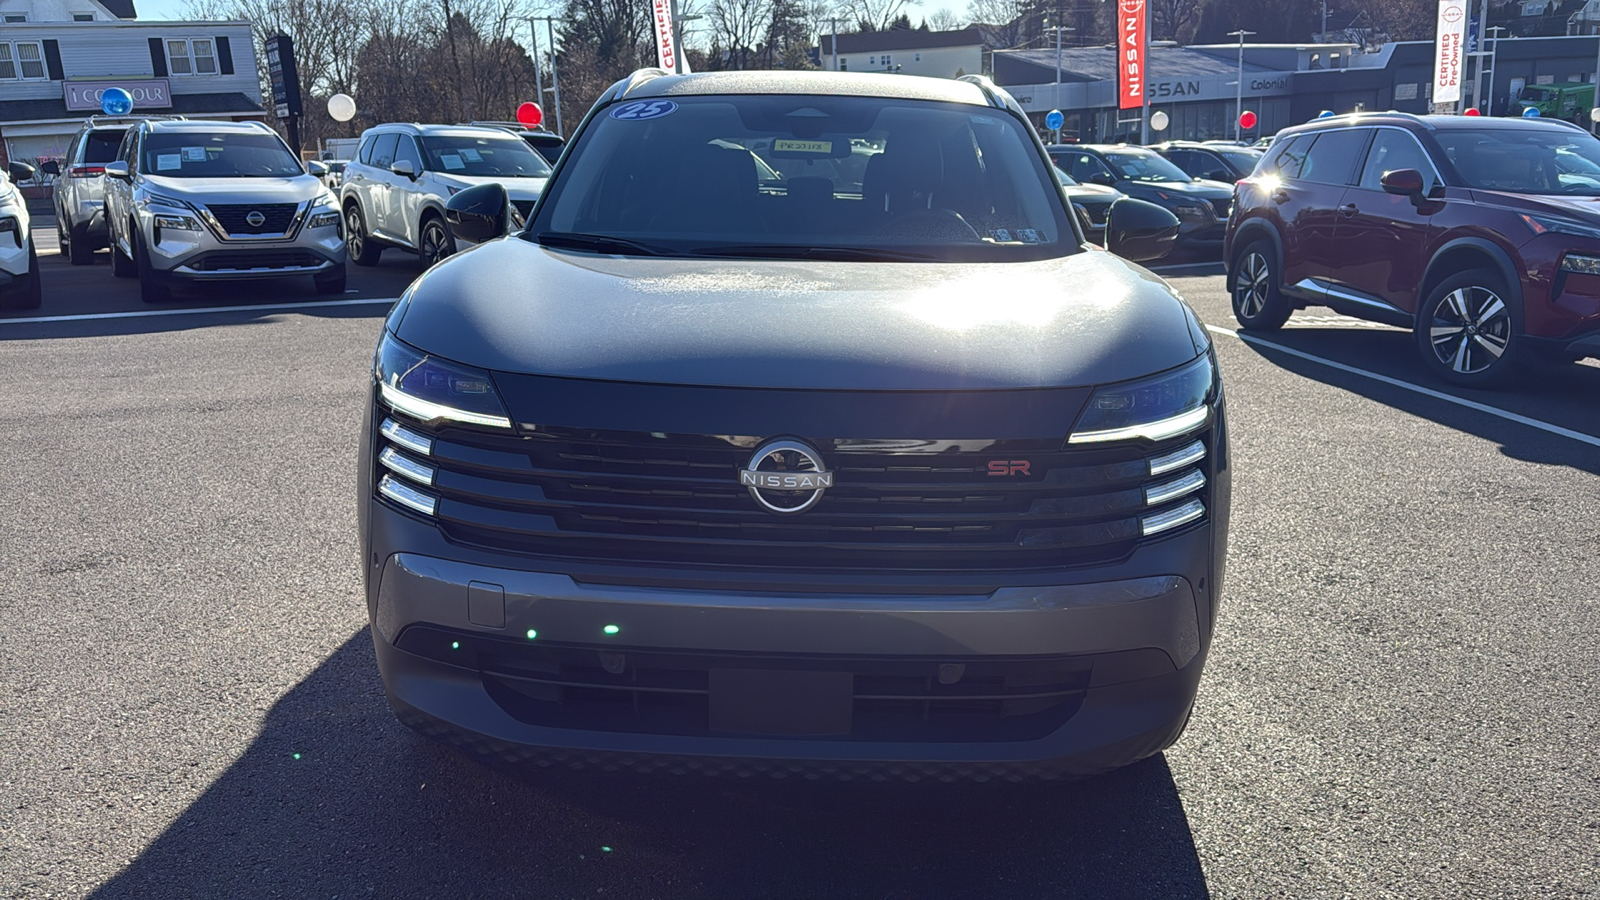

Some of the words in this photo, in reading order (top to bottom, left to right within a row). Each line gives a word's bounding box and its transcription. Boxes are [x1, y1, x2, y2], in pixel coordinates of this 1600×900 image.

[1126, 17, 1140, 97] NISSAN
[1440, 33, 1450, 87] CERTIFIED
[1449, 33, 1460, 86] Pre-Owned
[1149, 81, 1200, 98] SSAN
[1251, 77, 1288, 91] Colonial
[617, 101, 668, 119] 25
[988, 460, 1031, 476] SR
[743, 473, 830, 487] NISSAN
